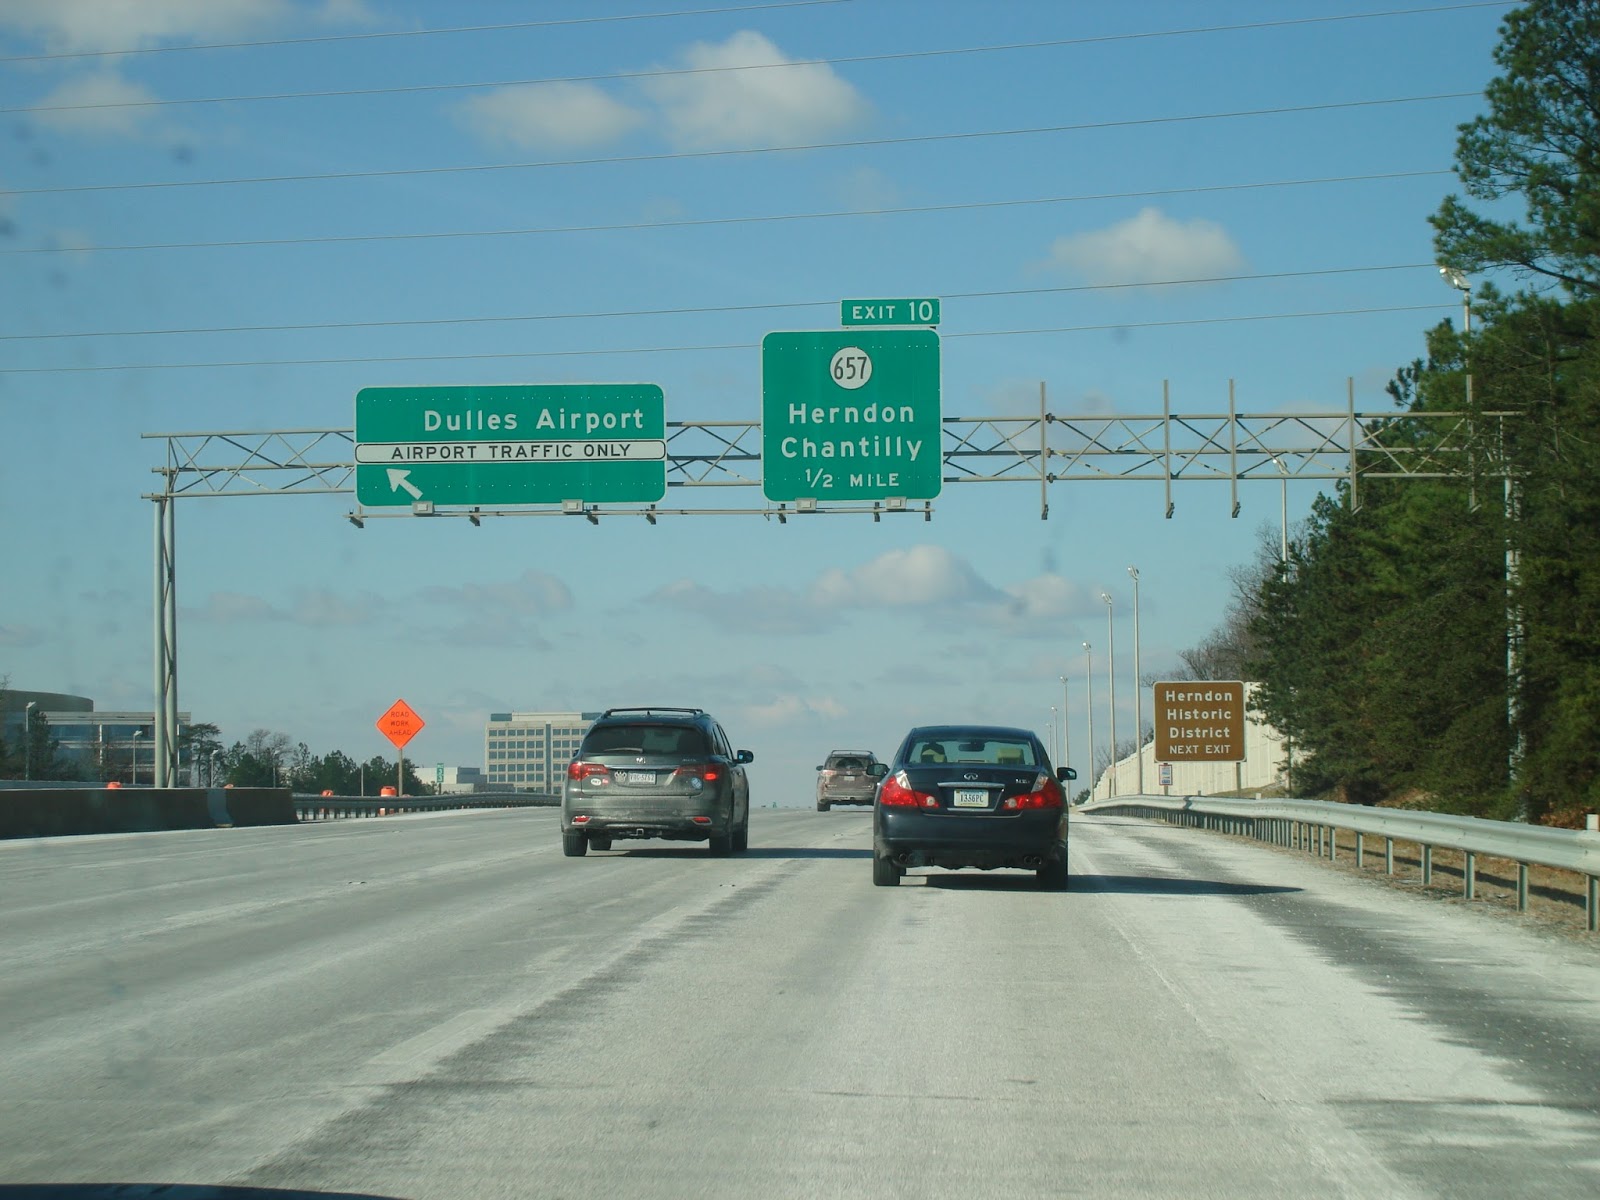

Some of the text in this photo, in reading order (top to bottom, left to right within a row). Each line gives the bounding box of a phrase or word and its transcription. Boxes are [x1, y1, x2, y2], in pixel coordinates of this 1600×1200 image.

[852, 300, 933, 321] EXIT 10
[833, 356, 868, 380] 657
[424, 408, 644, 434] Dulles Airport
[788, 402, 914, 424] Herndon
[391, 443, 632, 460] AIRPORT TRAFFIC ONLY
[781, 435, 922, 462] Chantilly
[805, 467, 899, 488] 1/2 MILE
[1165, 690, 1233, 702] Herndon
[1167, 708, 1232, 720] Historic
[1169, 727, 1230, 738] District
[1169, 745, 1231, 754] NEXT EXIT
